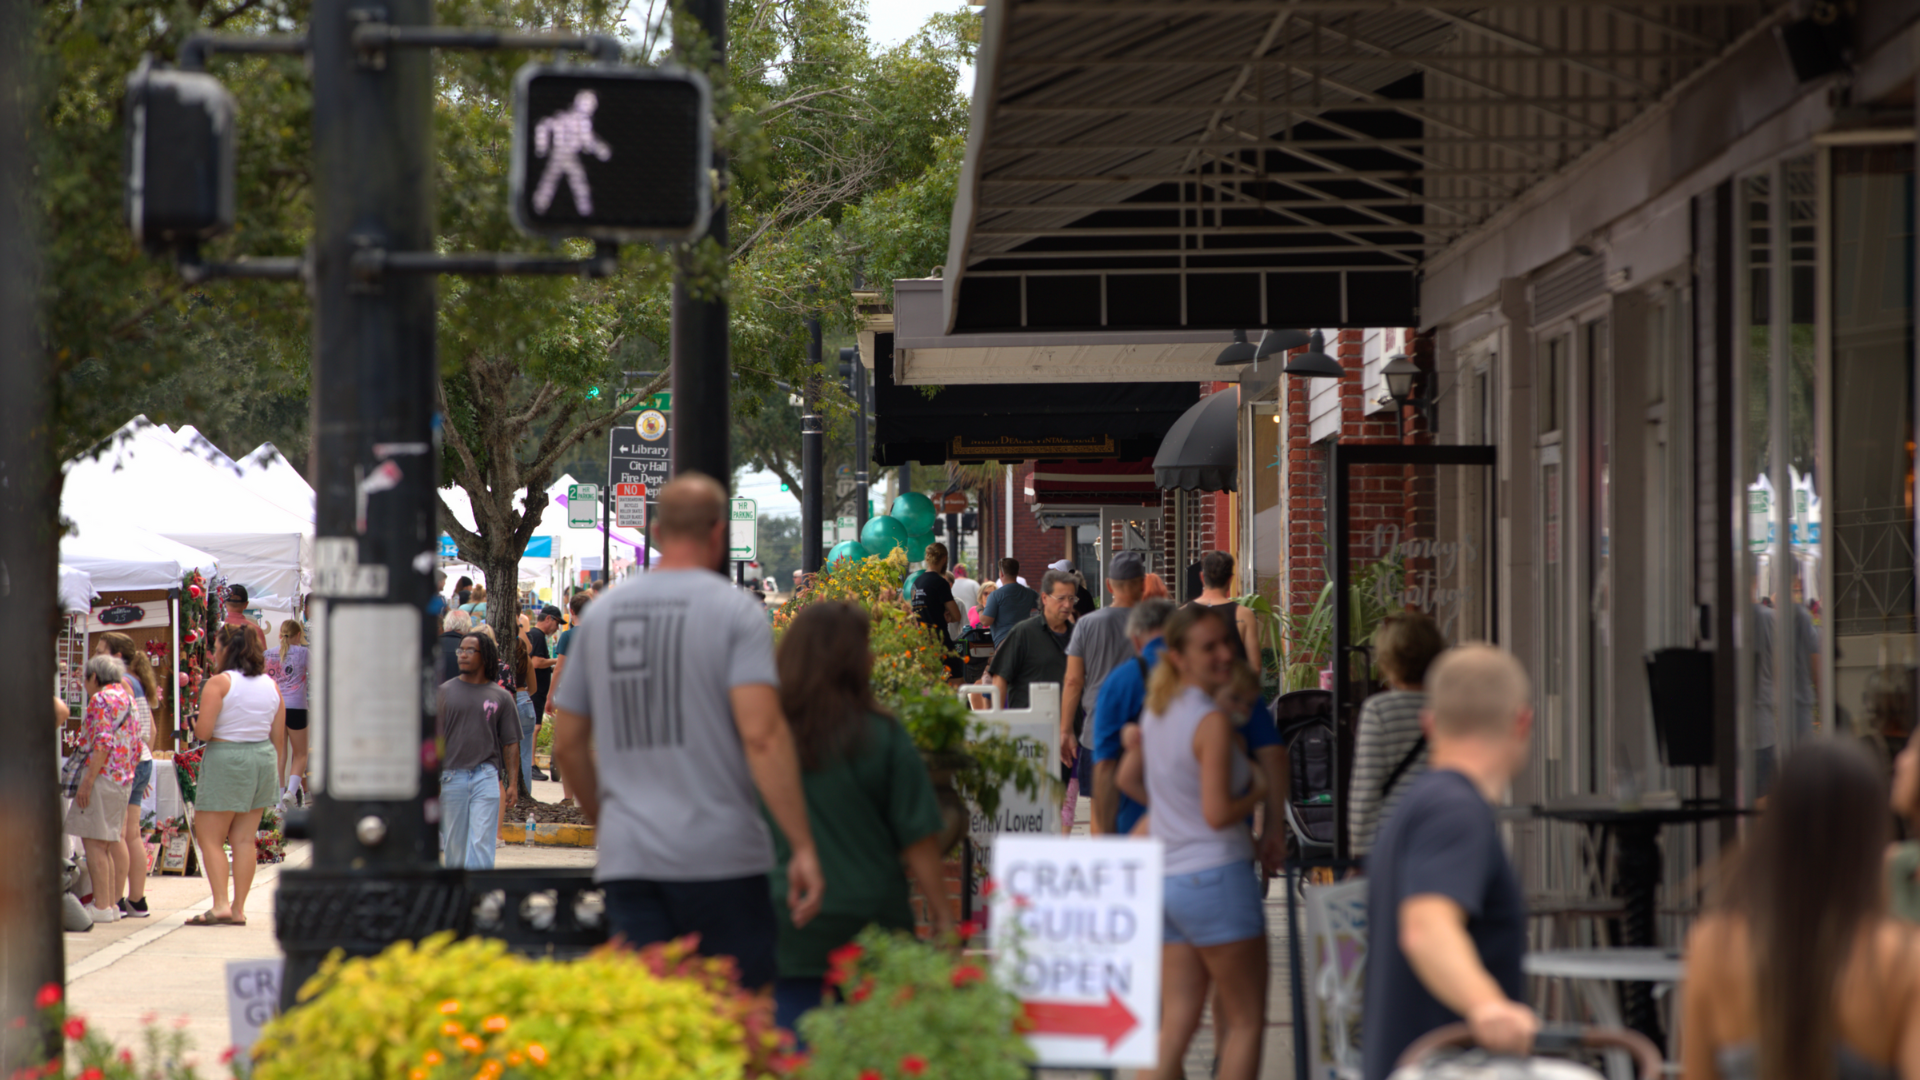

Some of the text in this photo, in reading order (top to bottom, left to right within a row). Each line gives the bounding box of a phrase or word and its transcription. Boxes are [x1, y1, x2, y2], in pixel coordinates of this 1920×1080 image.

[631, 444, 669, 457] Library
[629, 461, 668, 473] City Hall
[621, 472, 667, 486] Fire Dept.
[569, 487, 577, 499] 2
[624, 485, 638, 496] NO
[738, 501, 748, 510] HR
[733, 511, 753, 519] PARKING
[1005, 808, 1044, 832] Loved
[1006, 858, 1144, 899] CRAFT
[1017, 903, 1137, 945] GUILD
[1017, 955, 1134, 995] OPEN
